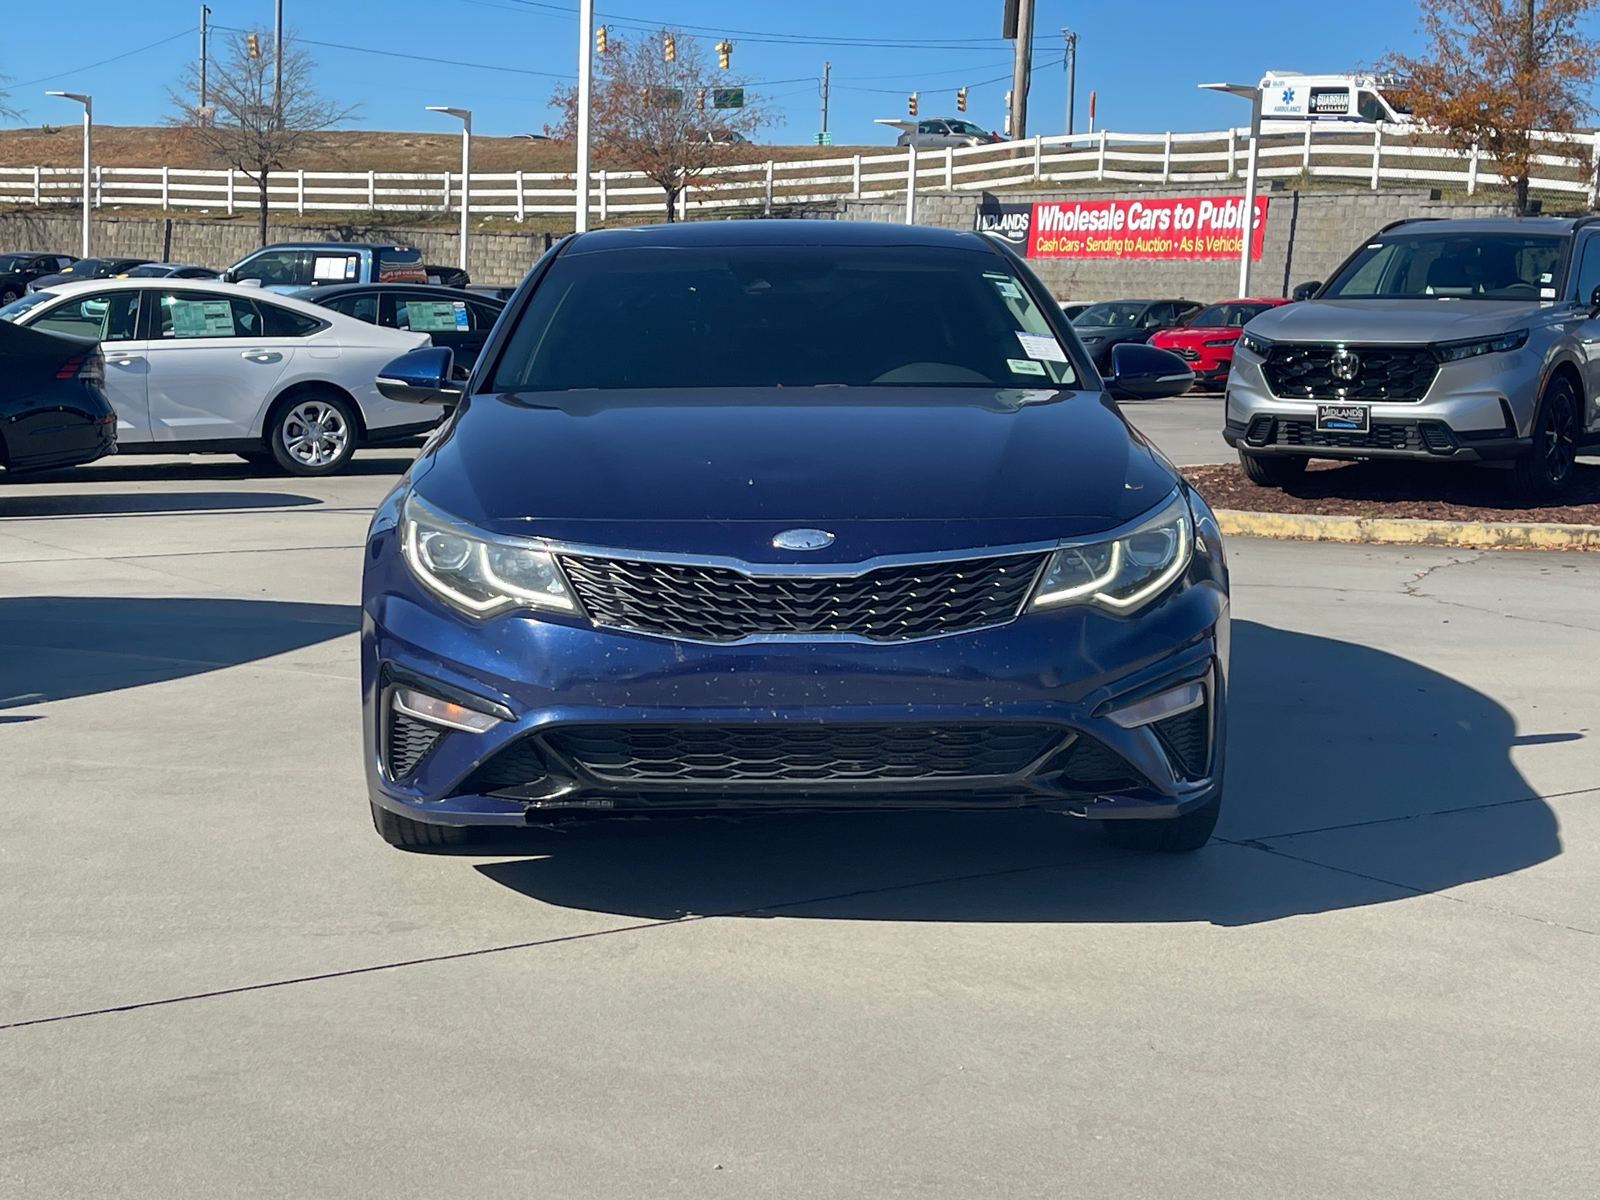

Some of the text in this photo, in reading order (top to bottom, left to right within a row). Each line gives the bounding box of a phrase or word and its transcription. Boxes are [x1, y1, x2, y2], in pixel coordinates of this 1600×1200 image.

[1317, 95, 1348, 106] GUARDIAN
[1037, 199, 1261, 231] Wholesale Cars to Publc
[1036, 237, 1058, 252] Cash
[1059, 237, 1080, 252] Cars
[1085, 236, 1123, 255] Sending
[1124, 238, 1134, 252] to
[1134, 236, 1172, 252] Auction
[1179, 236, 1194, 252] As
[1195, 236, 1204, 252] Is
[1321, 408, 1363, 417] MIDLANDS
